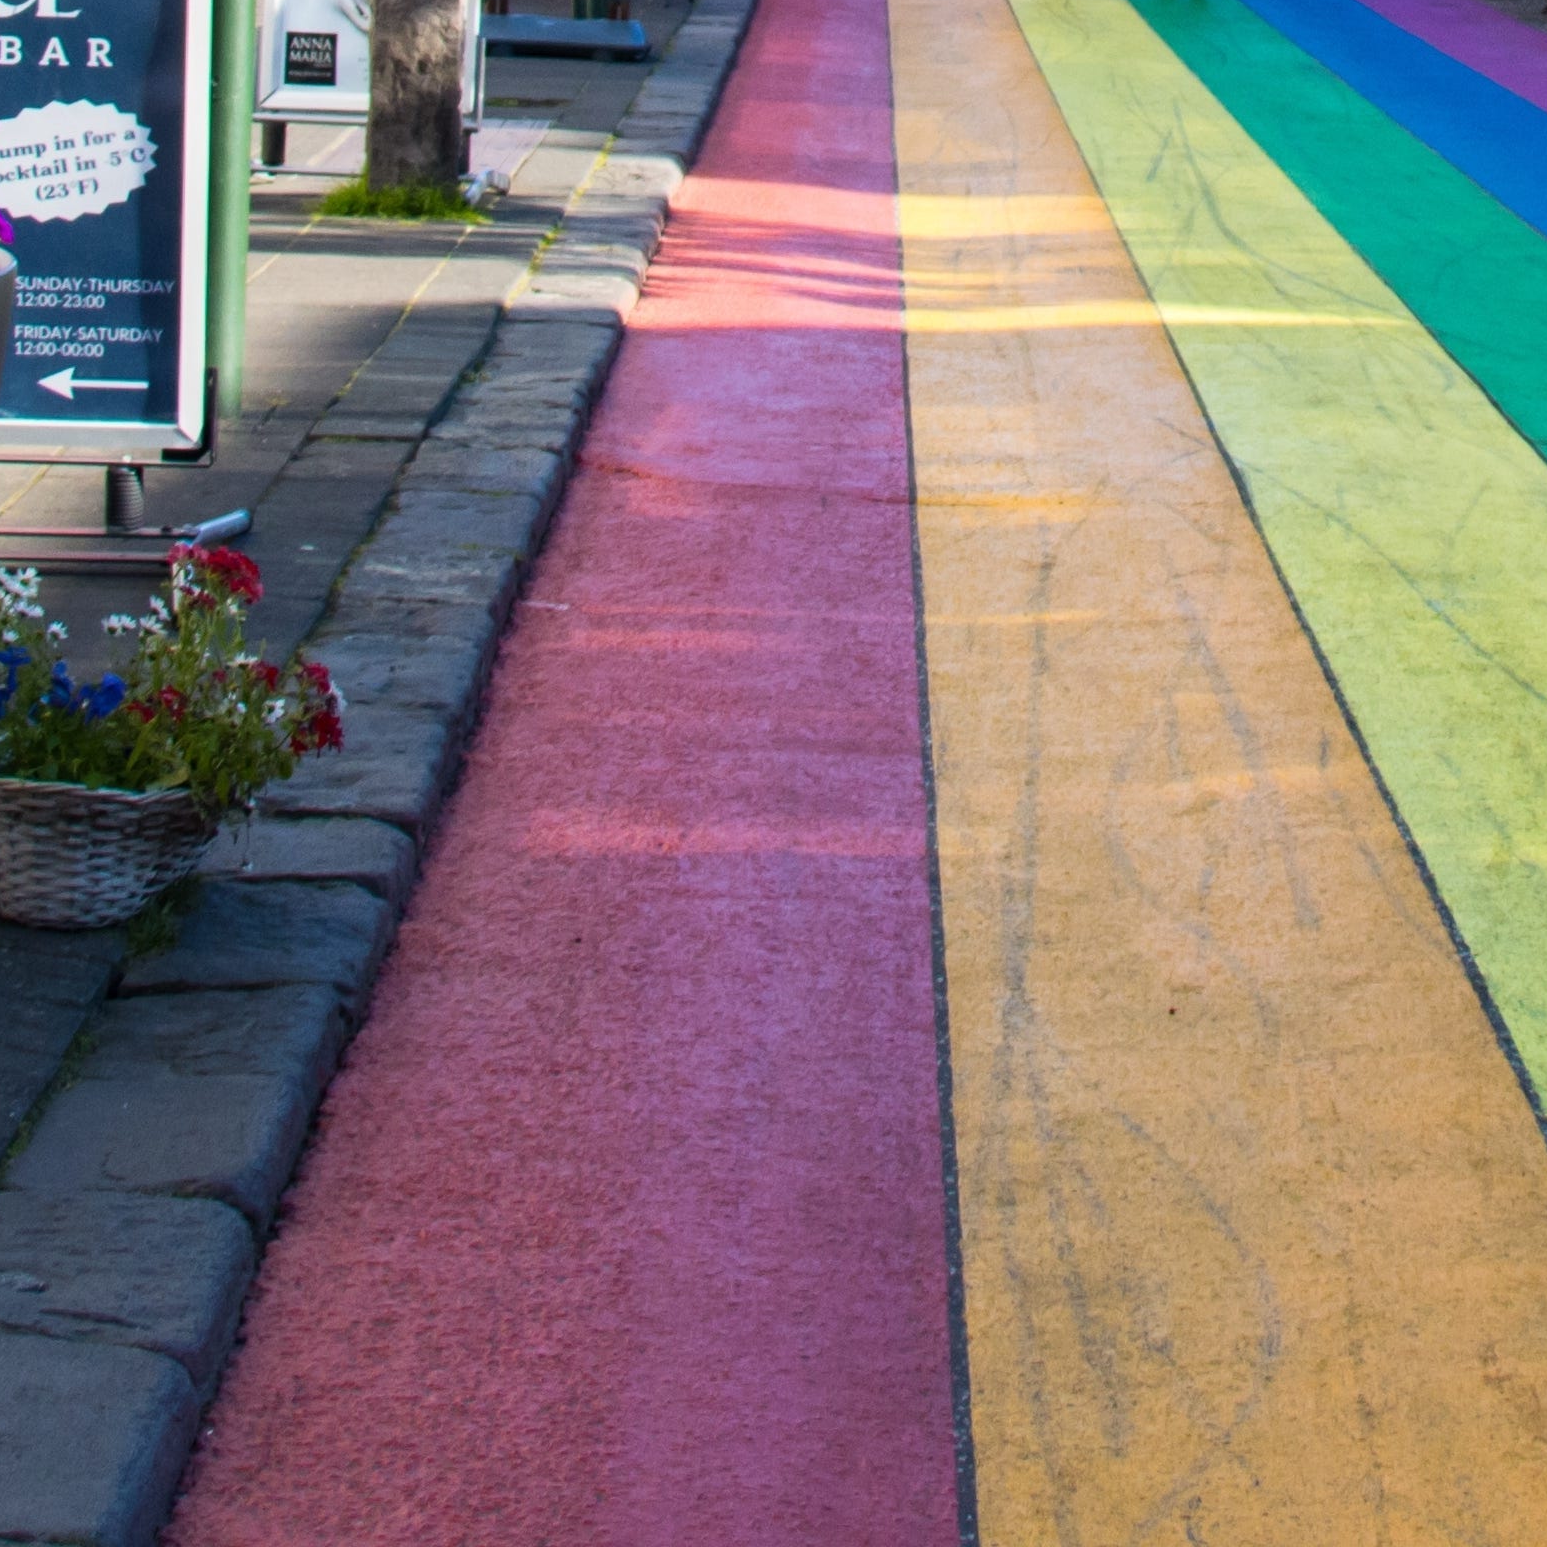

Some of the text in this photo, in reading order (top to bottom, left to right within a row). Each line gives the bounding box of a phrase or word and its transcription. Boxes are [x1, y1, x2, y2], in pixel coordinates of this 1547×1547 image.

[290, 36, 332, 51] ANNA
[289, 50, 332, 63] MARIA
[53, 135, 76, 151] in
[82, 130, 117, 148] for
[123, 129, 136, 142] a
[75, 156, 97, 172] in
[14, 275, 176, 294] SUNDAY-THURSDAY
[15, 292, 106, 309] 12:00-23:00
[13, 323, 164, 344] FRIDAY-SATURDAY
[15, 341, 105, 358] 12:00-00:00
